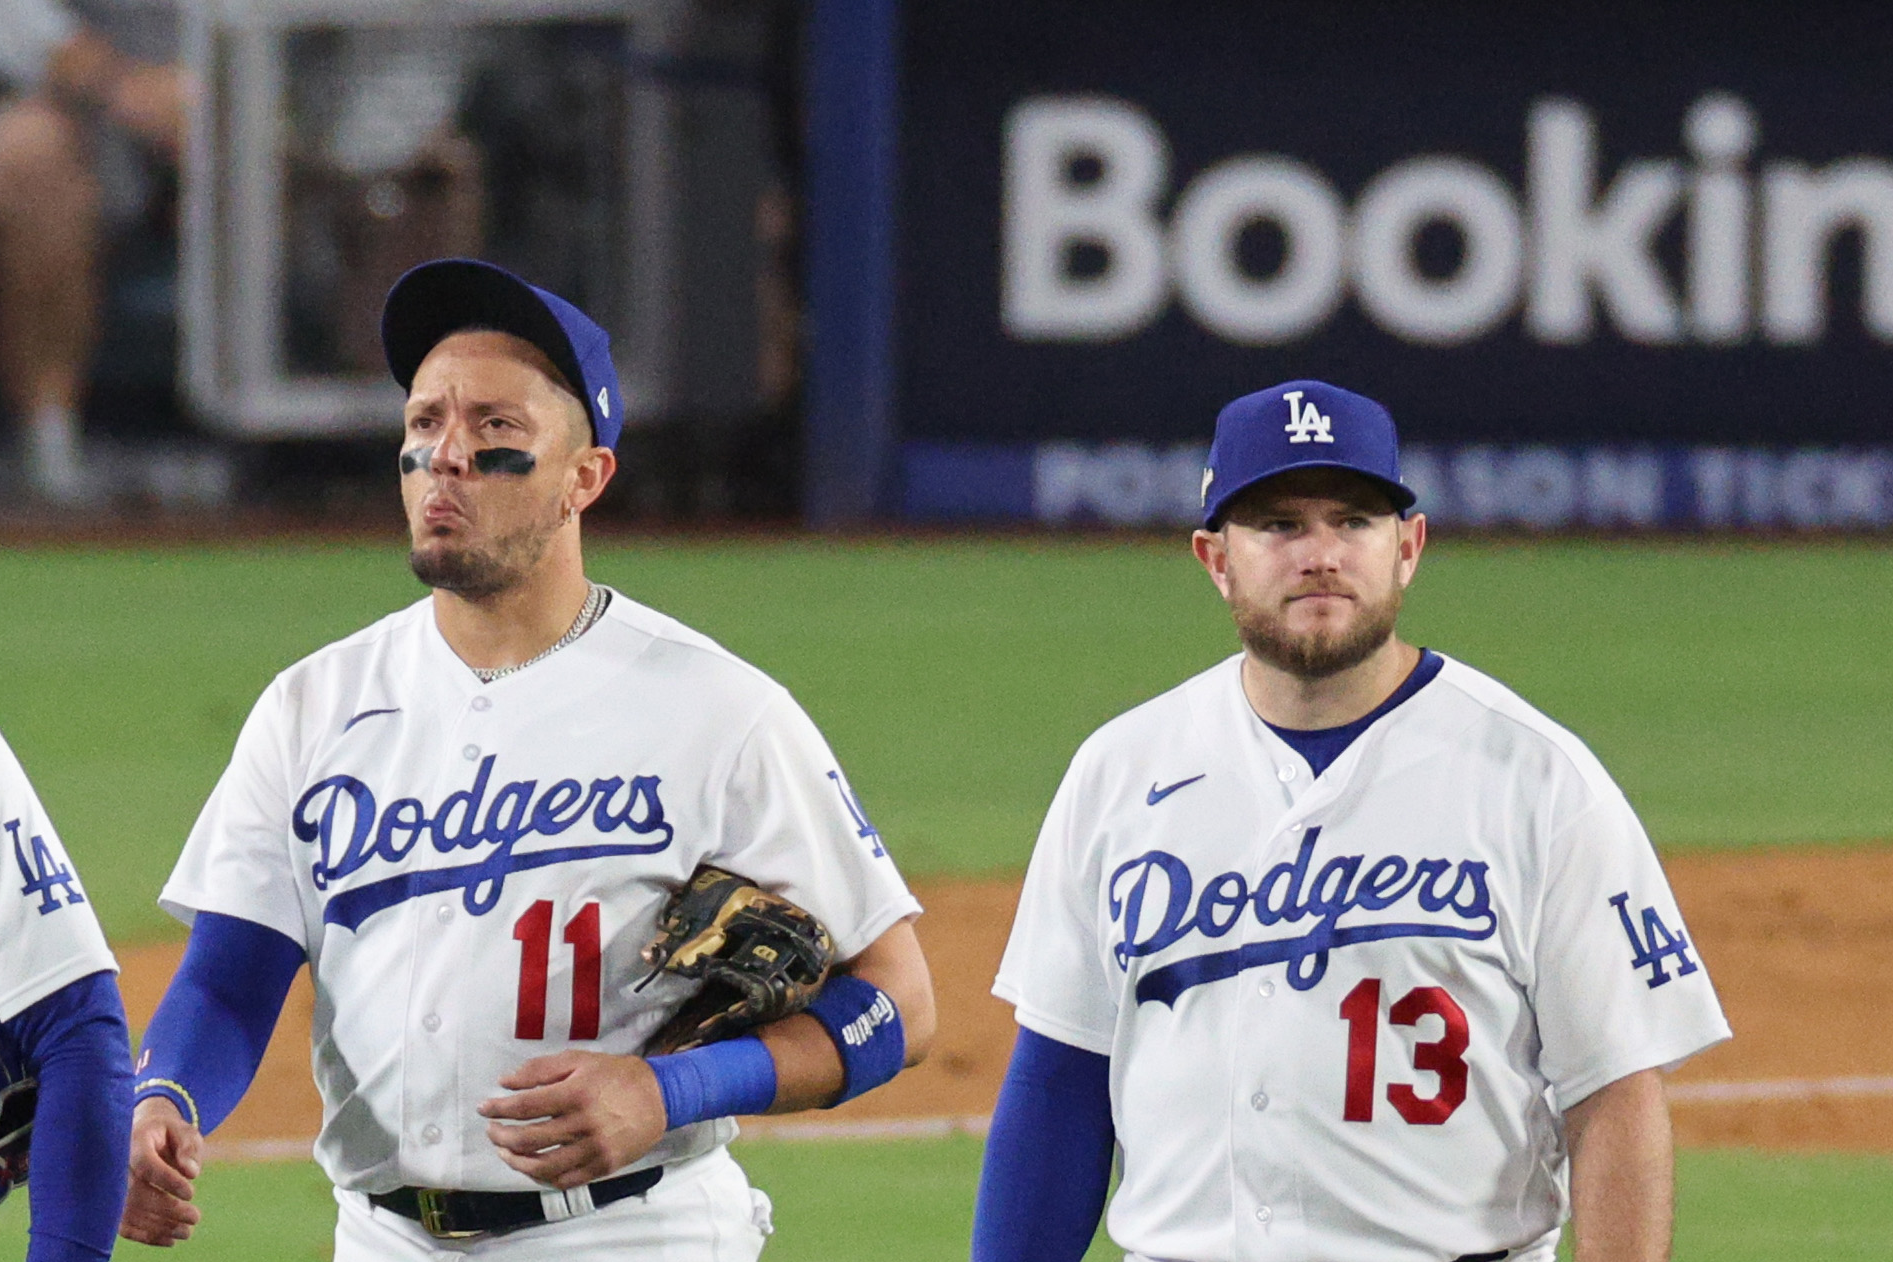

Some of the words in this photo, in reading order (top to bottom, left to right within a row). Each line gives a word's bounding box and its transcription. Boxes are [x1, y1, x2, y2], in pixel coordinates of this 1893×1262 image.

[1001, 96, 1893, 344] Bookin
[1282, 390, 1334, 443] LA
[4, 819, 85, 916] LA
[293, 754, 674, 918] Dodgers
[513, 899, 602, 1040] 11
[1109, 826, 1497, 994] Dodgers
[1609, 891, 1698, 989] LA
[1339, 978, 1470, 1125] 13
